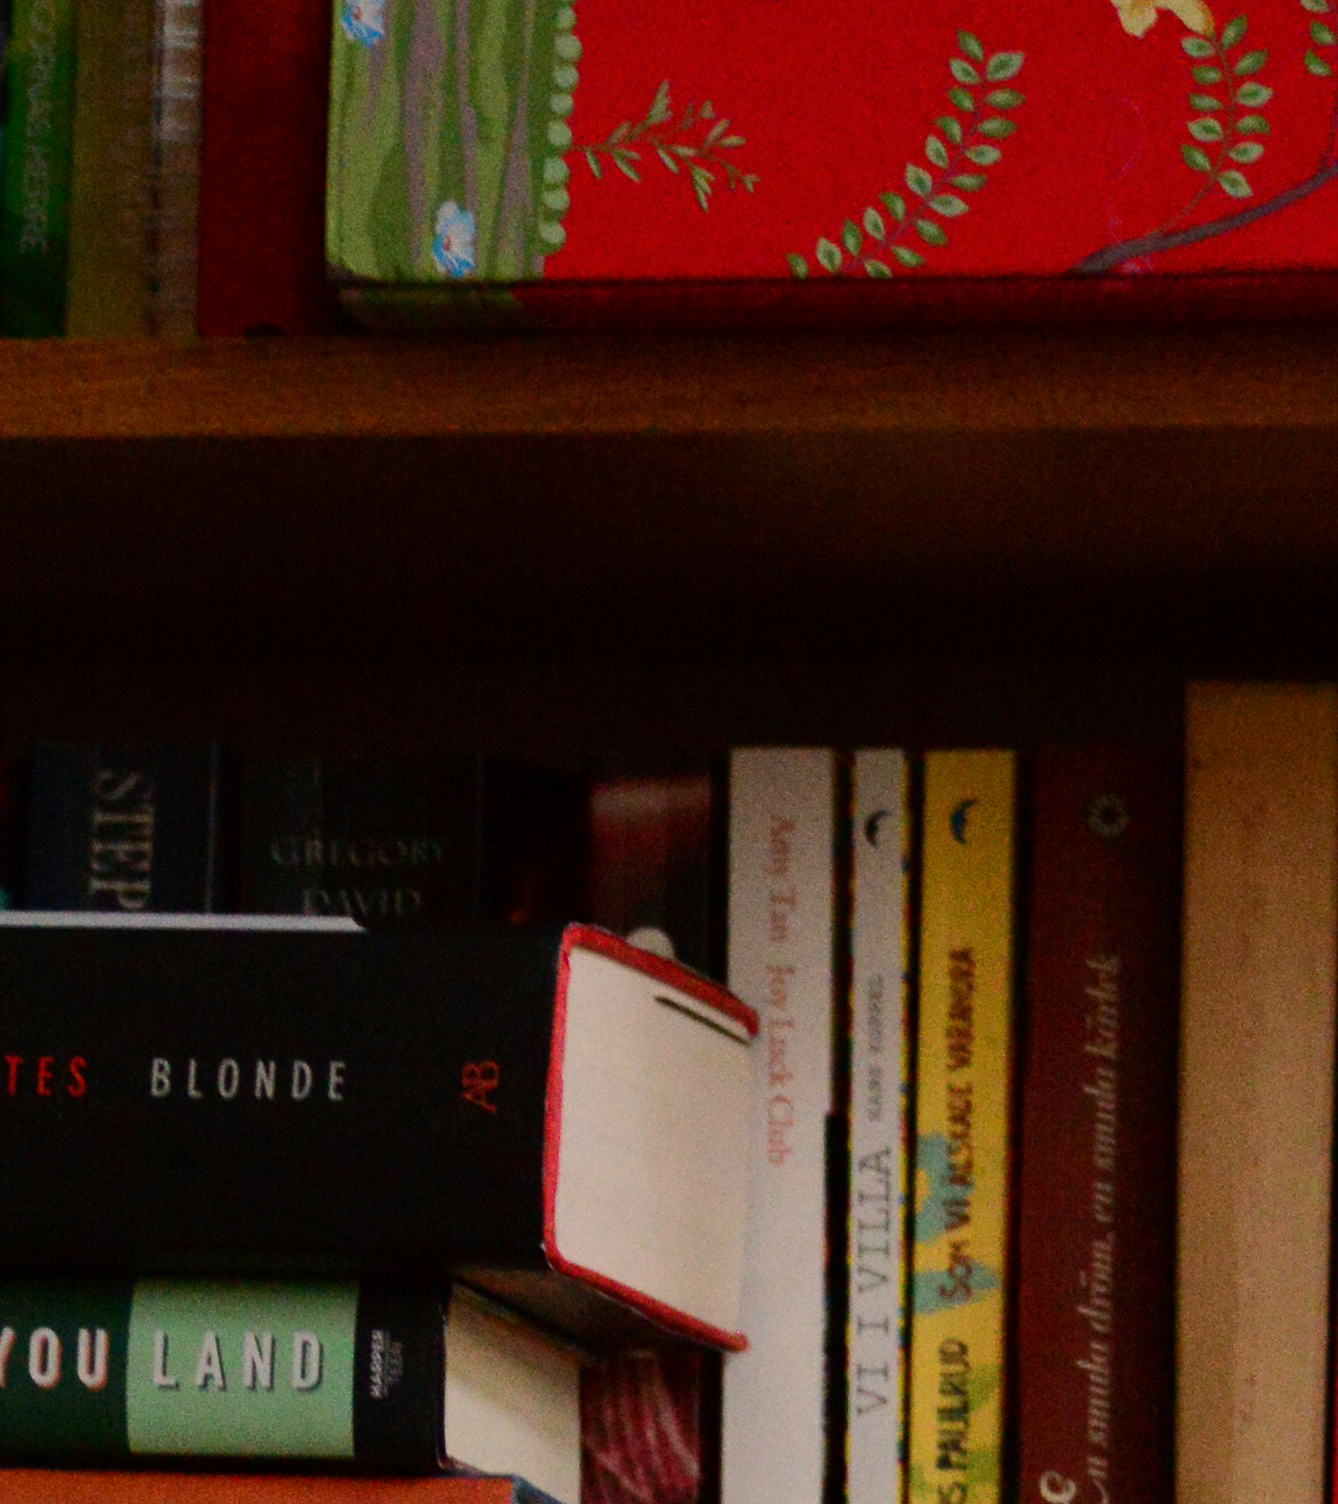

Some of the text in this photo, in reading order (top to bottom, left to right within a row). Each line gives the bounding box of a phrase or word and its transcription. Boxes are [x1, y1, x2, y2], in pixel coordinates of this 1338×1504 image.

[758, 814, 801, 1167] Amy Tan Joy Luck Club
[149, 1057, 347, 1101] BLONDE
[1091, 1180, 1114, 1224] en
[856, 1147, 892, 1416] VI I VILLA
[151, 1330, 325, 1393] LAND
[1075, 1353, 1110, 1447] smula
